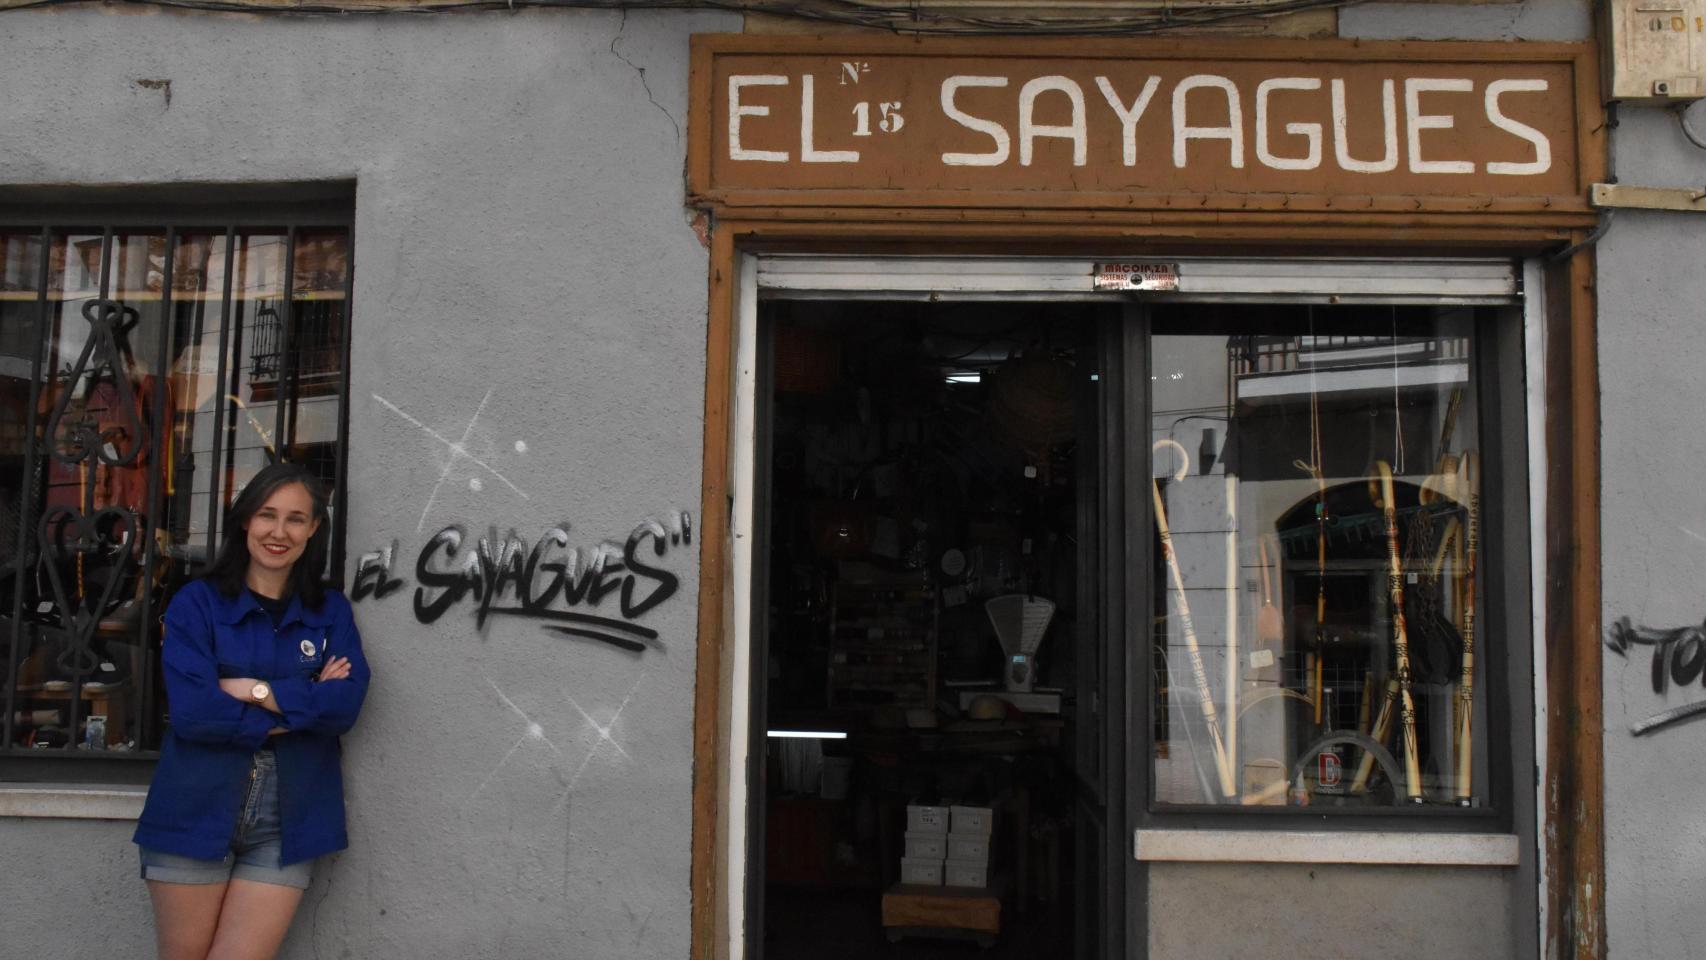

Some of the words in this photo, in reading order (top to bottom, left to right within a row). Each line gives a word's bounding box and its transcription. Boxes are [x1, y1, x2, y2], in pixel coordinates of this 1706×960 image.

[728, 74, 860, 163] EL
[941, 75, 1551, 174] SAYAGUES
[852, 101, 905, 136] 15
[352, 542, 404, 602] EL
